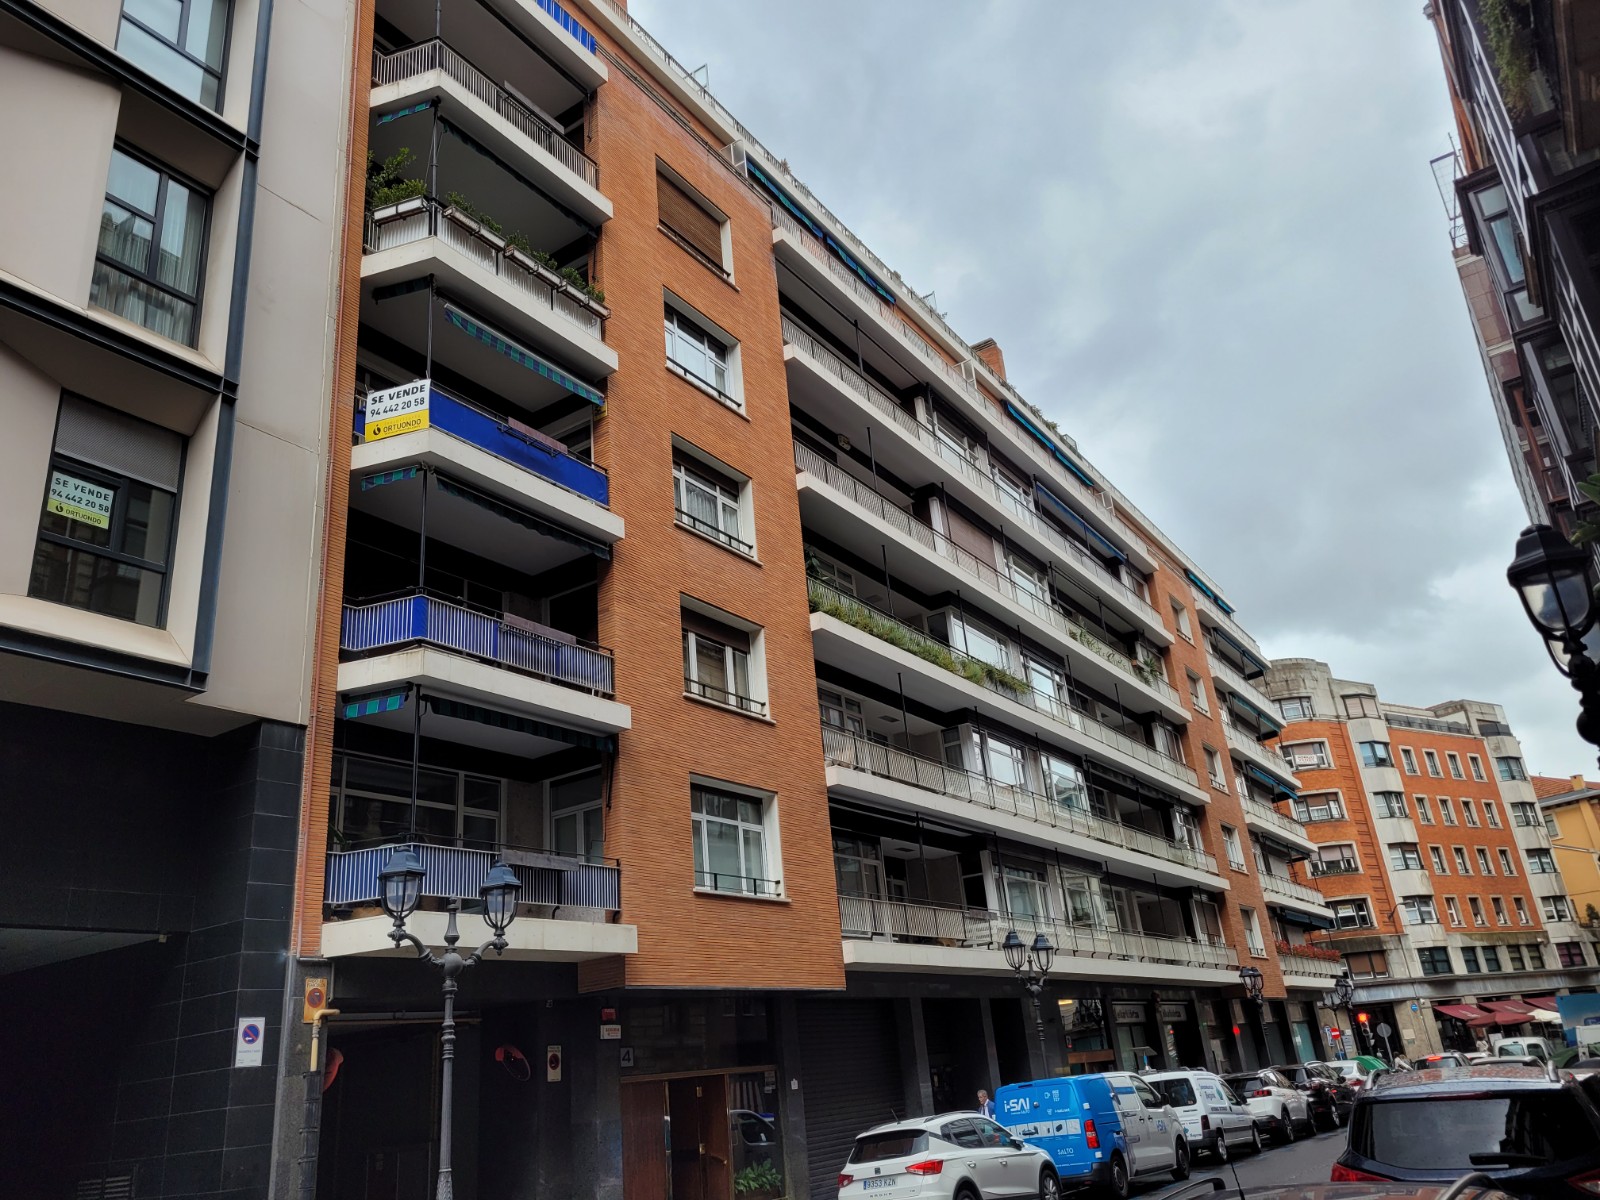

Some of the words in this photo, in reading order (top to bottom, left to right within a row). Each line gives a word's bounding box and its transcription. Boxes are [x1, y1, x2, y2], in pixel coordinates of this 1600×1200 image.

[371, 394, 384, 405] SE
[388, 384, 426, 401] VENDE
[370, 408, 381, 417] 94
[383, 403, 399, 414] 442
[401, 400, 412, 410] 20
[414, 397, 425, 407] 58
[383, 419, 422, 433] ORTUONDO
[55, 477, 69, 488] SE
[73, 482, 110, 502] VENDE
[51, 488, 63, 498] 94
[65, 493, 83, 505] 442
[85, 499, 96, 509] 20
[98, 503, 110, 513] 58
[65, 508, 102, 525] ORTUONDO
[621, 1049, 632, 1064] 4
[1057, 1147, 1074, 1155] SALTO
[867, 1180, 883, 1189] 9353
